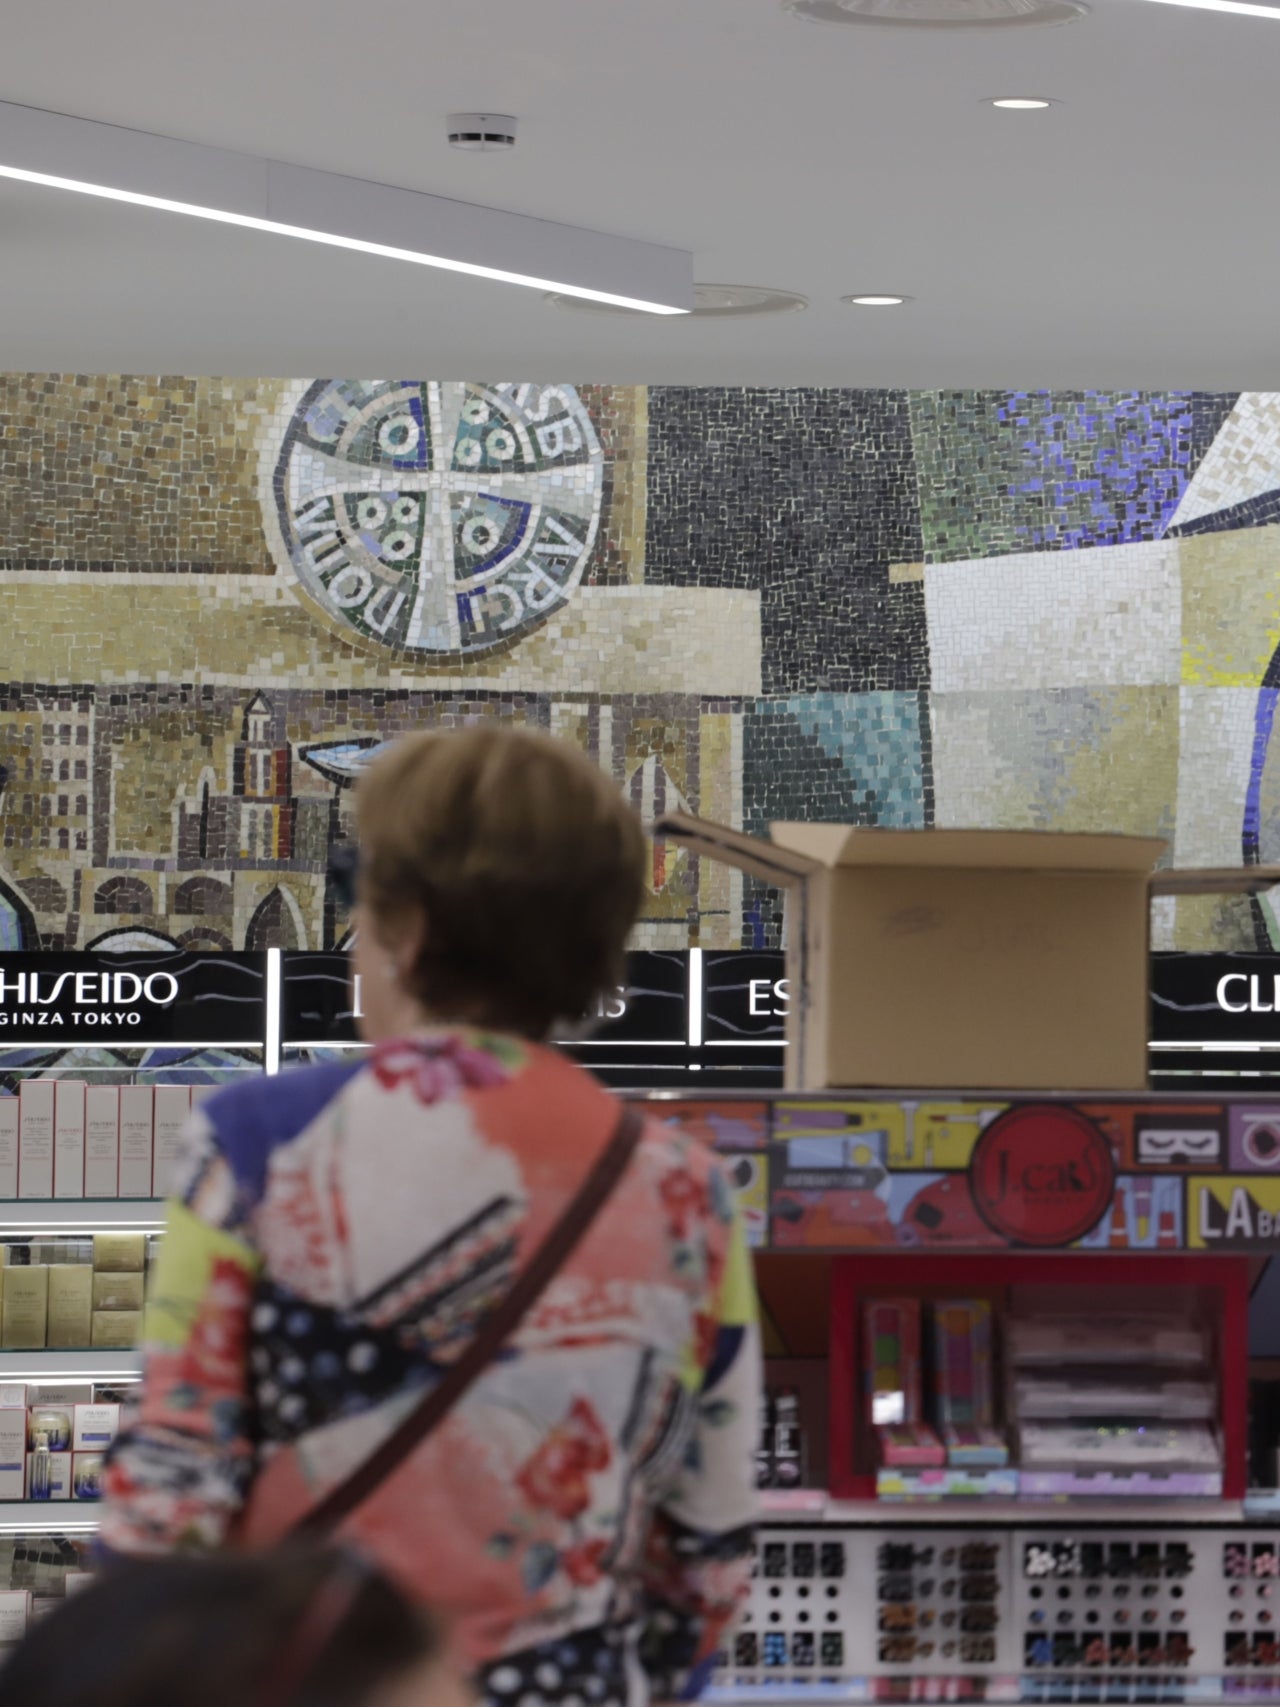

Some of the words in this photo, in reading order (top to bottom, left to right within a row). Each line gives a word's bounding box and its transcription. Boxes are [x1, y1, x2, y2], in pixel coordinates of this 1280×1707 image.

[0, 967, 179, 1005] HISEIDO
[0, 1012, 64, 1026] GINZA
[71, 1012, 141, 1026] TOKYO
[1199, 1186, 1254, 1238] LA
